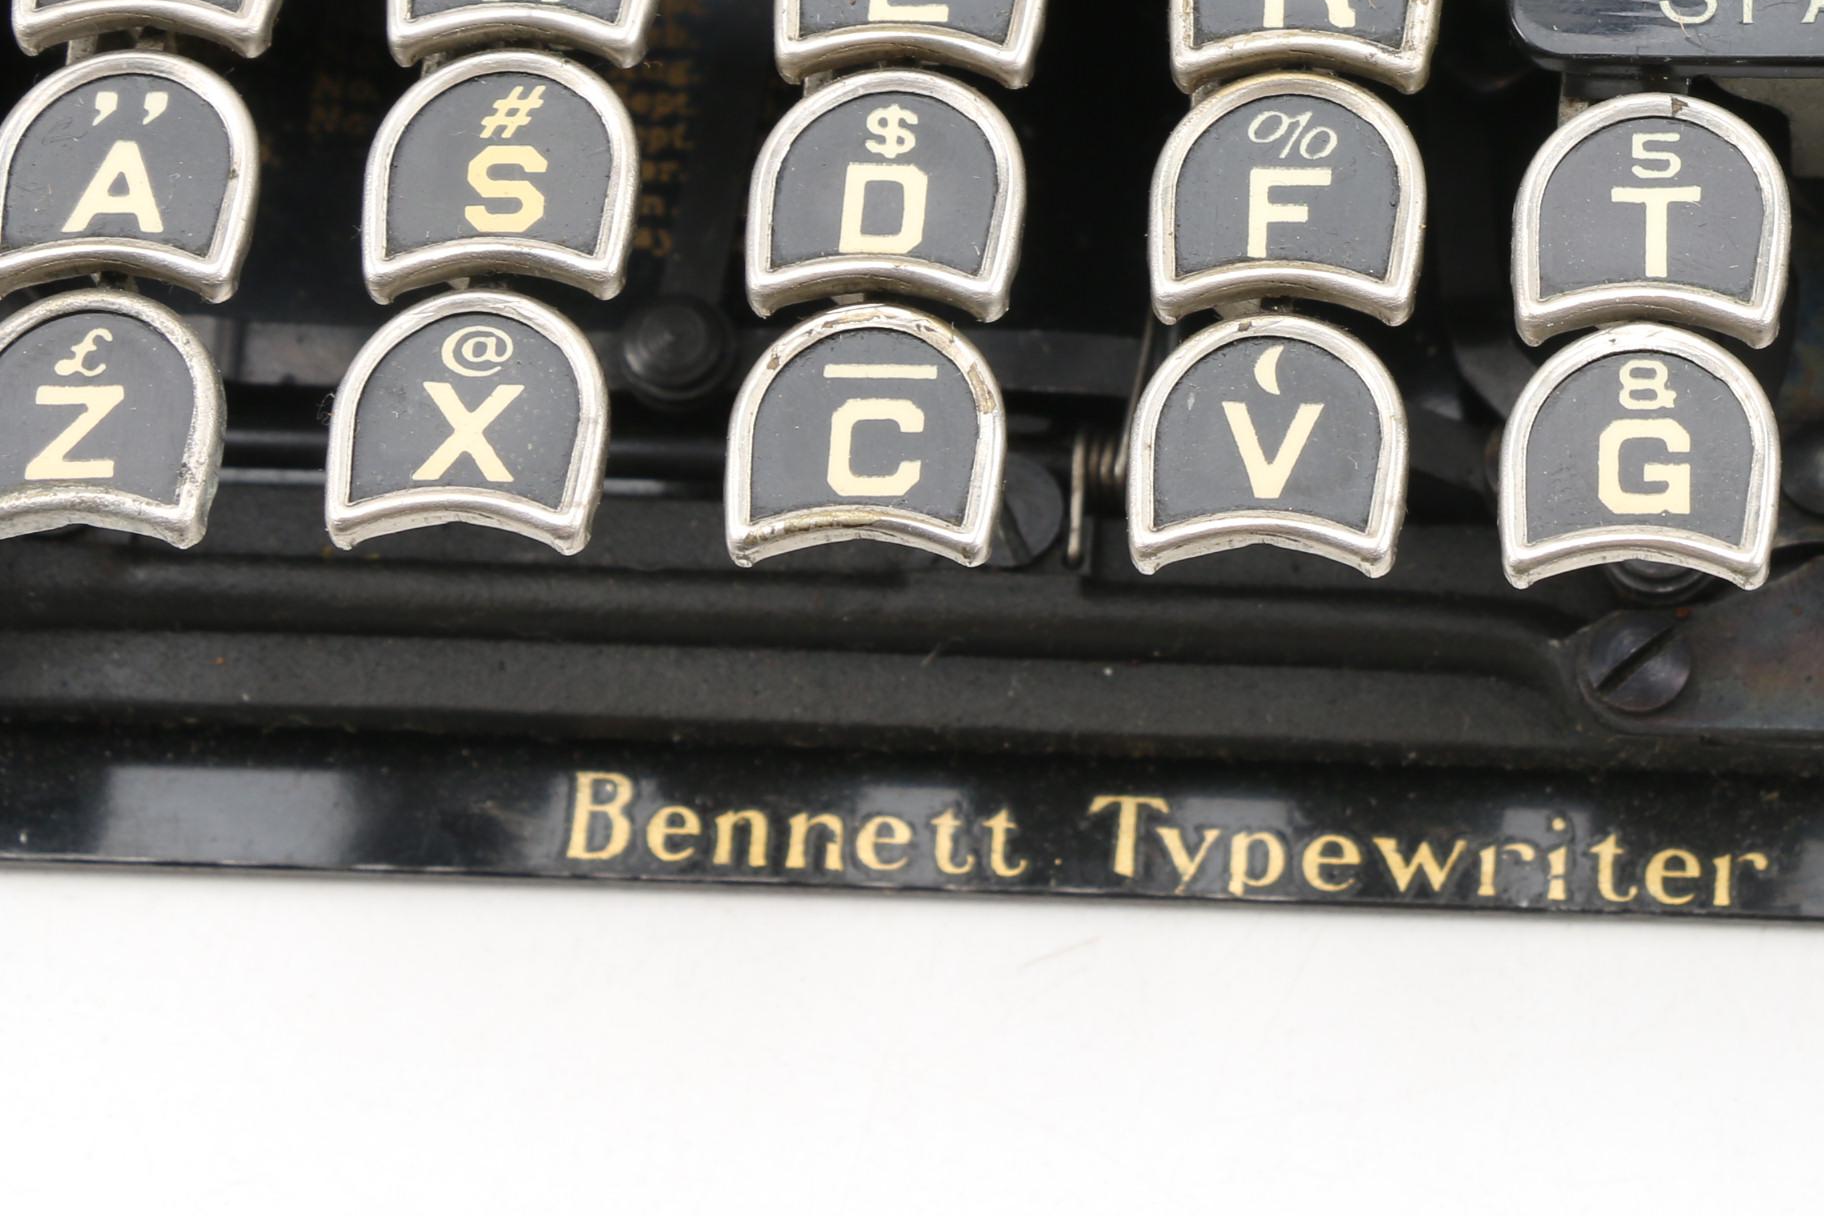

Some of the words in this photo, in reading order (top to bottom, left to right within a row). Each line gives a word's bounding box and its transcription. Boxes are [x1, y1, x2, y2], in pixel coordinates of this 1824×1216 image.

[60, 140, 165, 233] A
[464, 145, 548, 233] S
[1631, 132, 1681, 179] 5
[838, 162, 928, 256] D
[1247, 165, 1332, 258] F
[1611, 185, 1702, 278] T
[24, 384, 125, 480] Z
[409, 381, 525, 482] X
[827, 398, 925, 497] C
[1221, 401, 1324, 499] V
[1597, 417, 1691, 515] G
[567, 773, 1025, 876] Bennett
[1089, 796, 1768, 906] Typewriter
